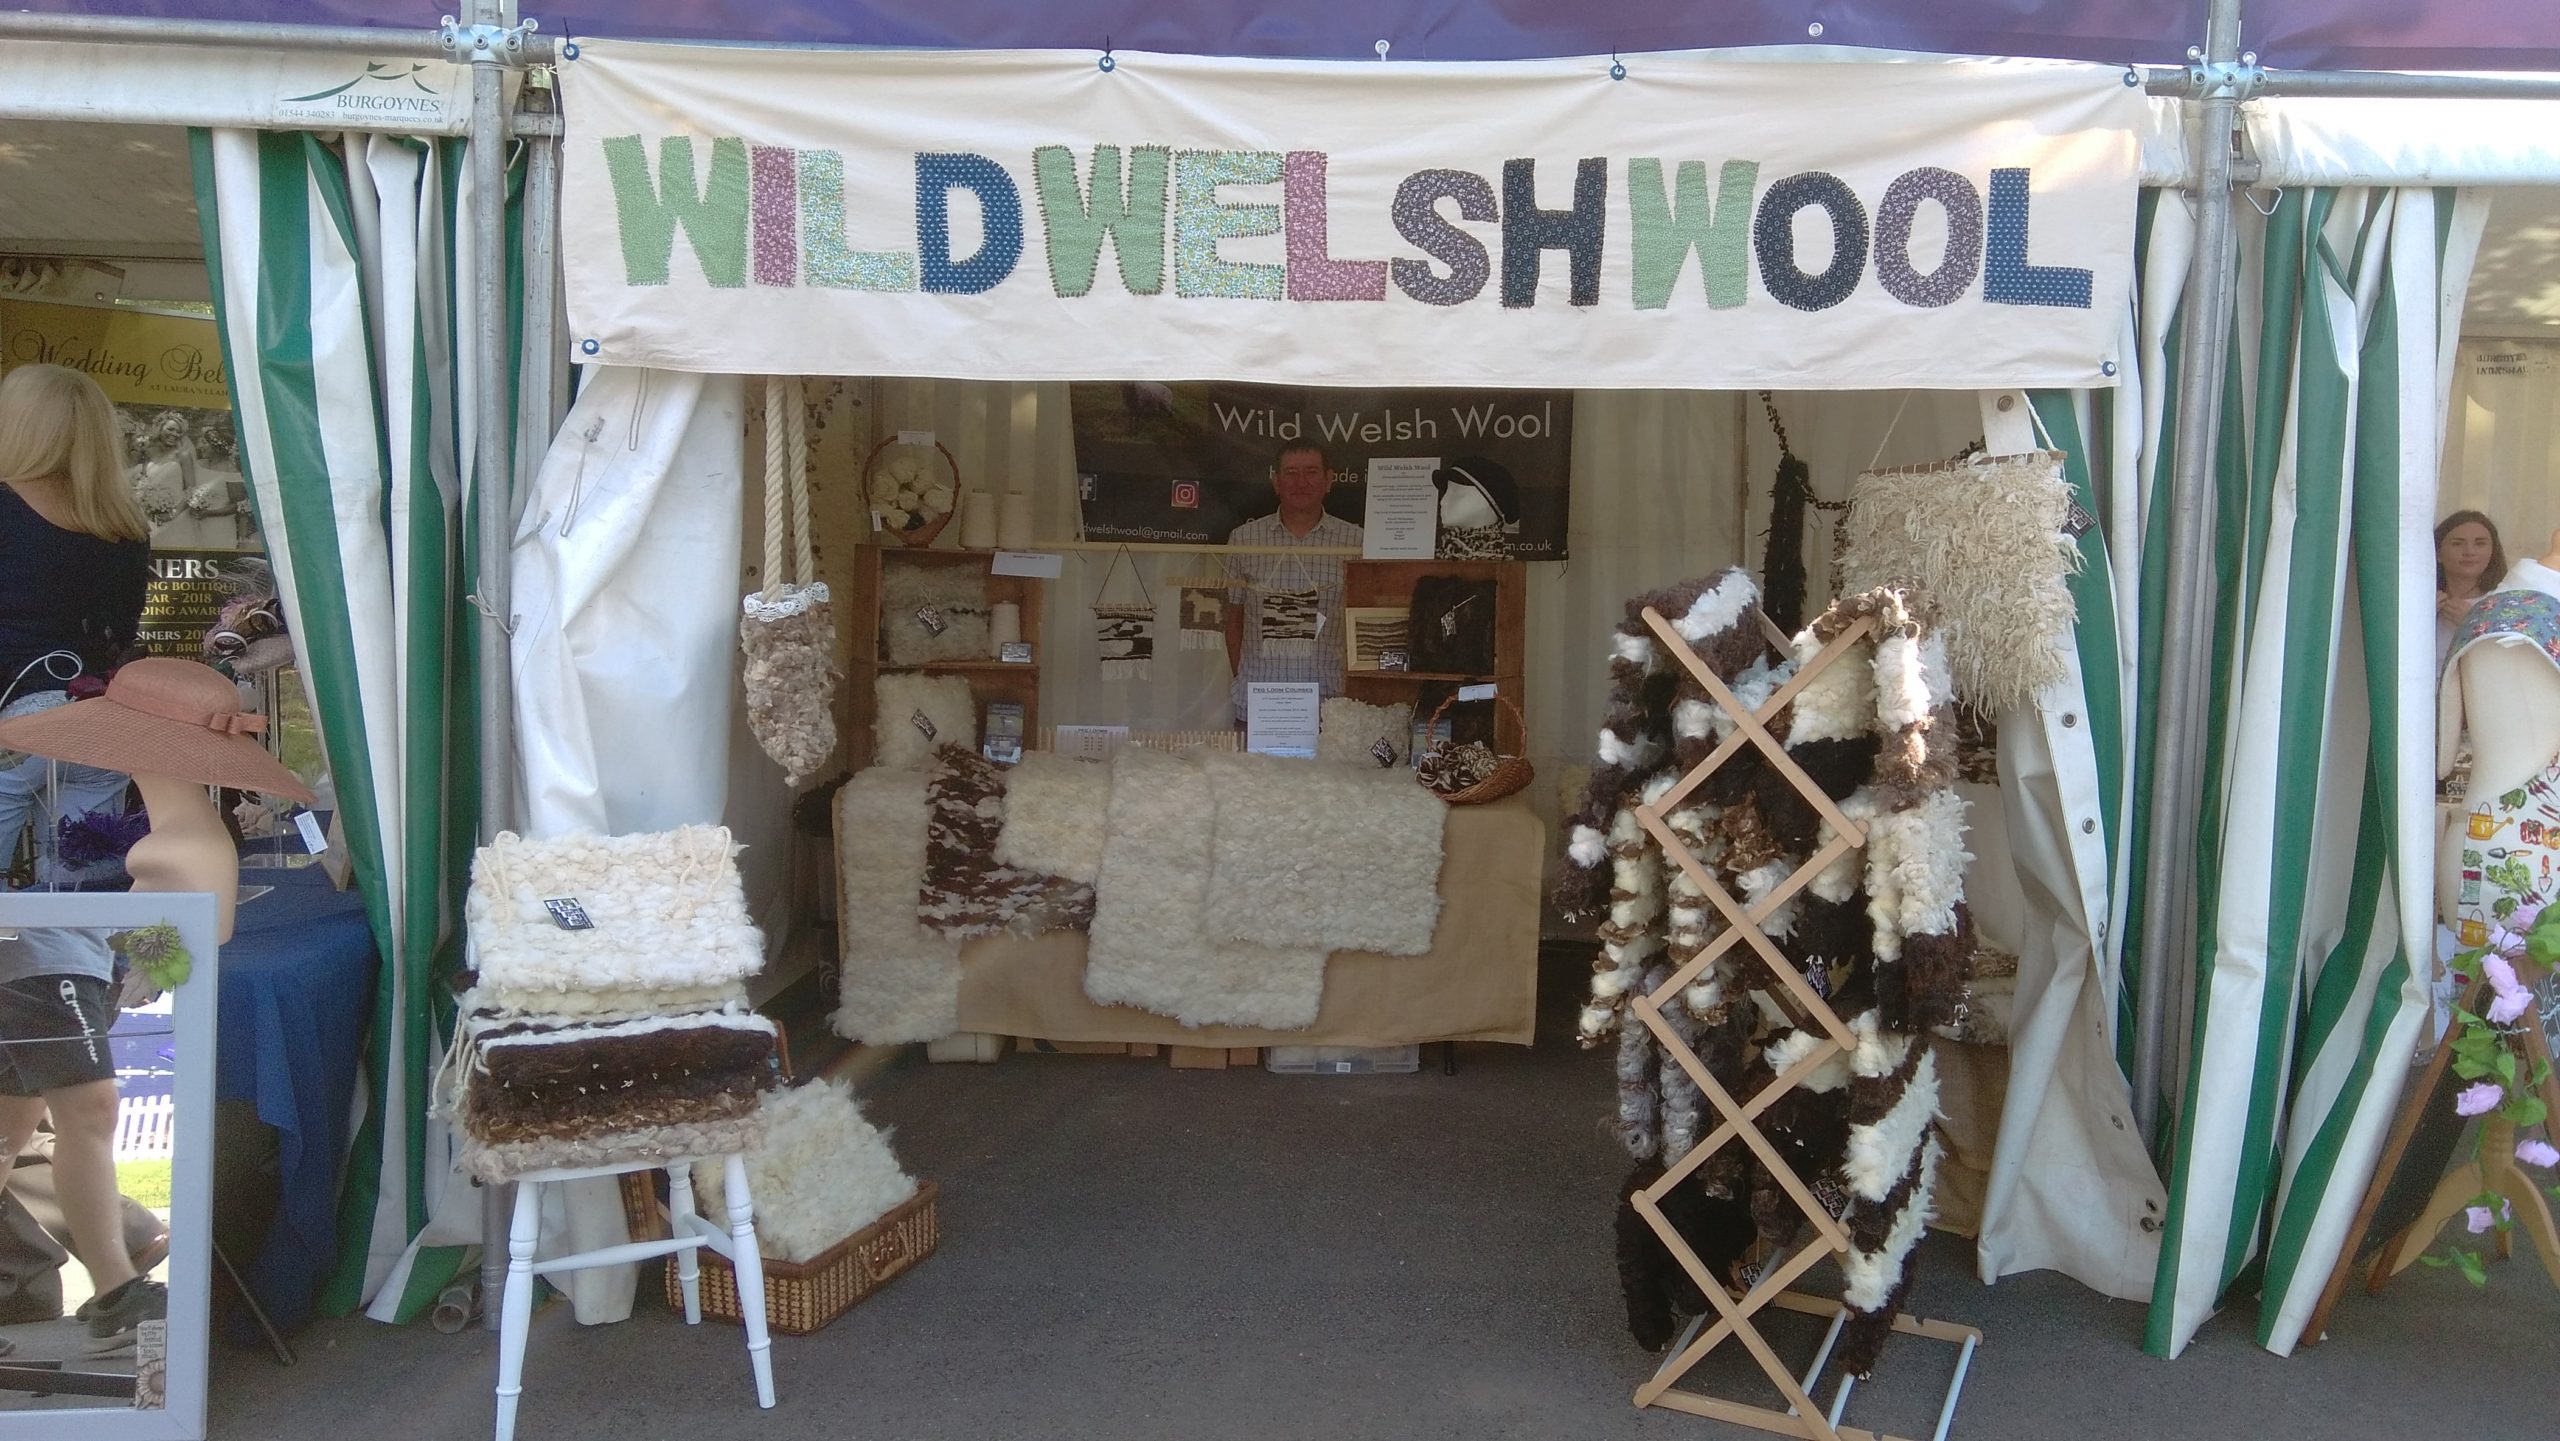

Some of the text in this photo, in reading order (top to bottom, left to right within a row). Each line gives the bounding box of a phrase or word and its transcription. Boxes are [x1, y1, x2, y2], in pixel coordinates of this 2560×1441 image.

[336, 94, 440, 113] BURGOYNES
[278, 109, 444, 124] 01544 340283 burgoynes-marquees.co.uk
[12, 329, 150, 386] Wedding
[1213, 399, 1552, 443] Wild Welsh Wool
[172, 581, 240, 594] BOUTIQUE
[182, 593, 212, 604] 2018
